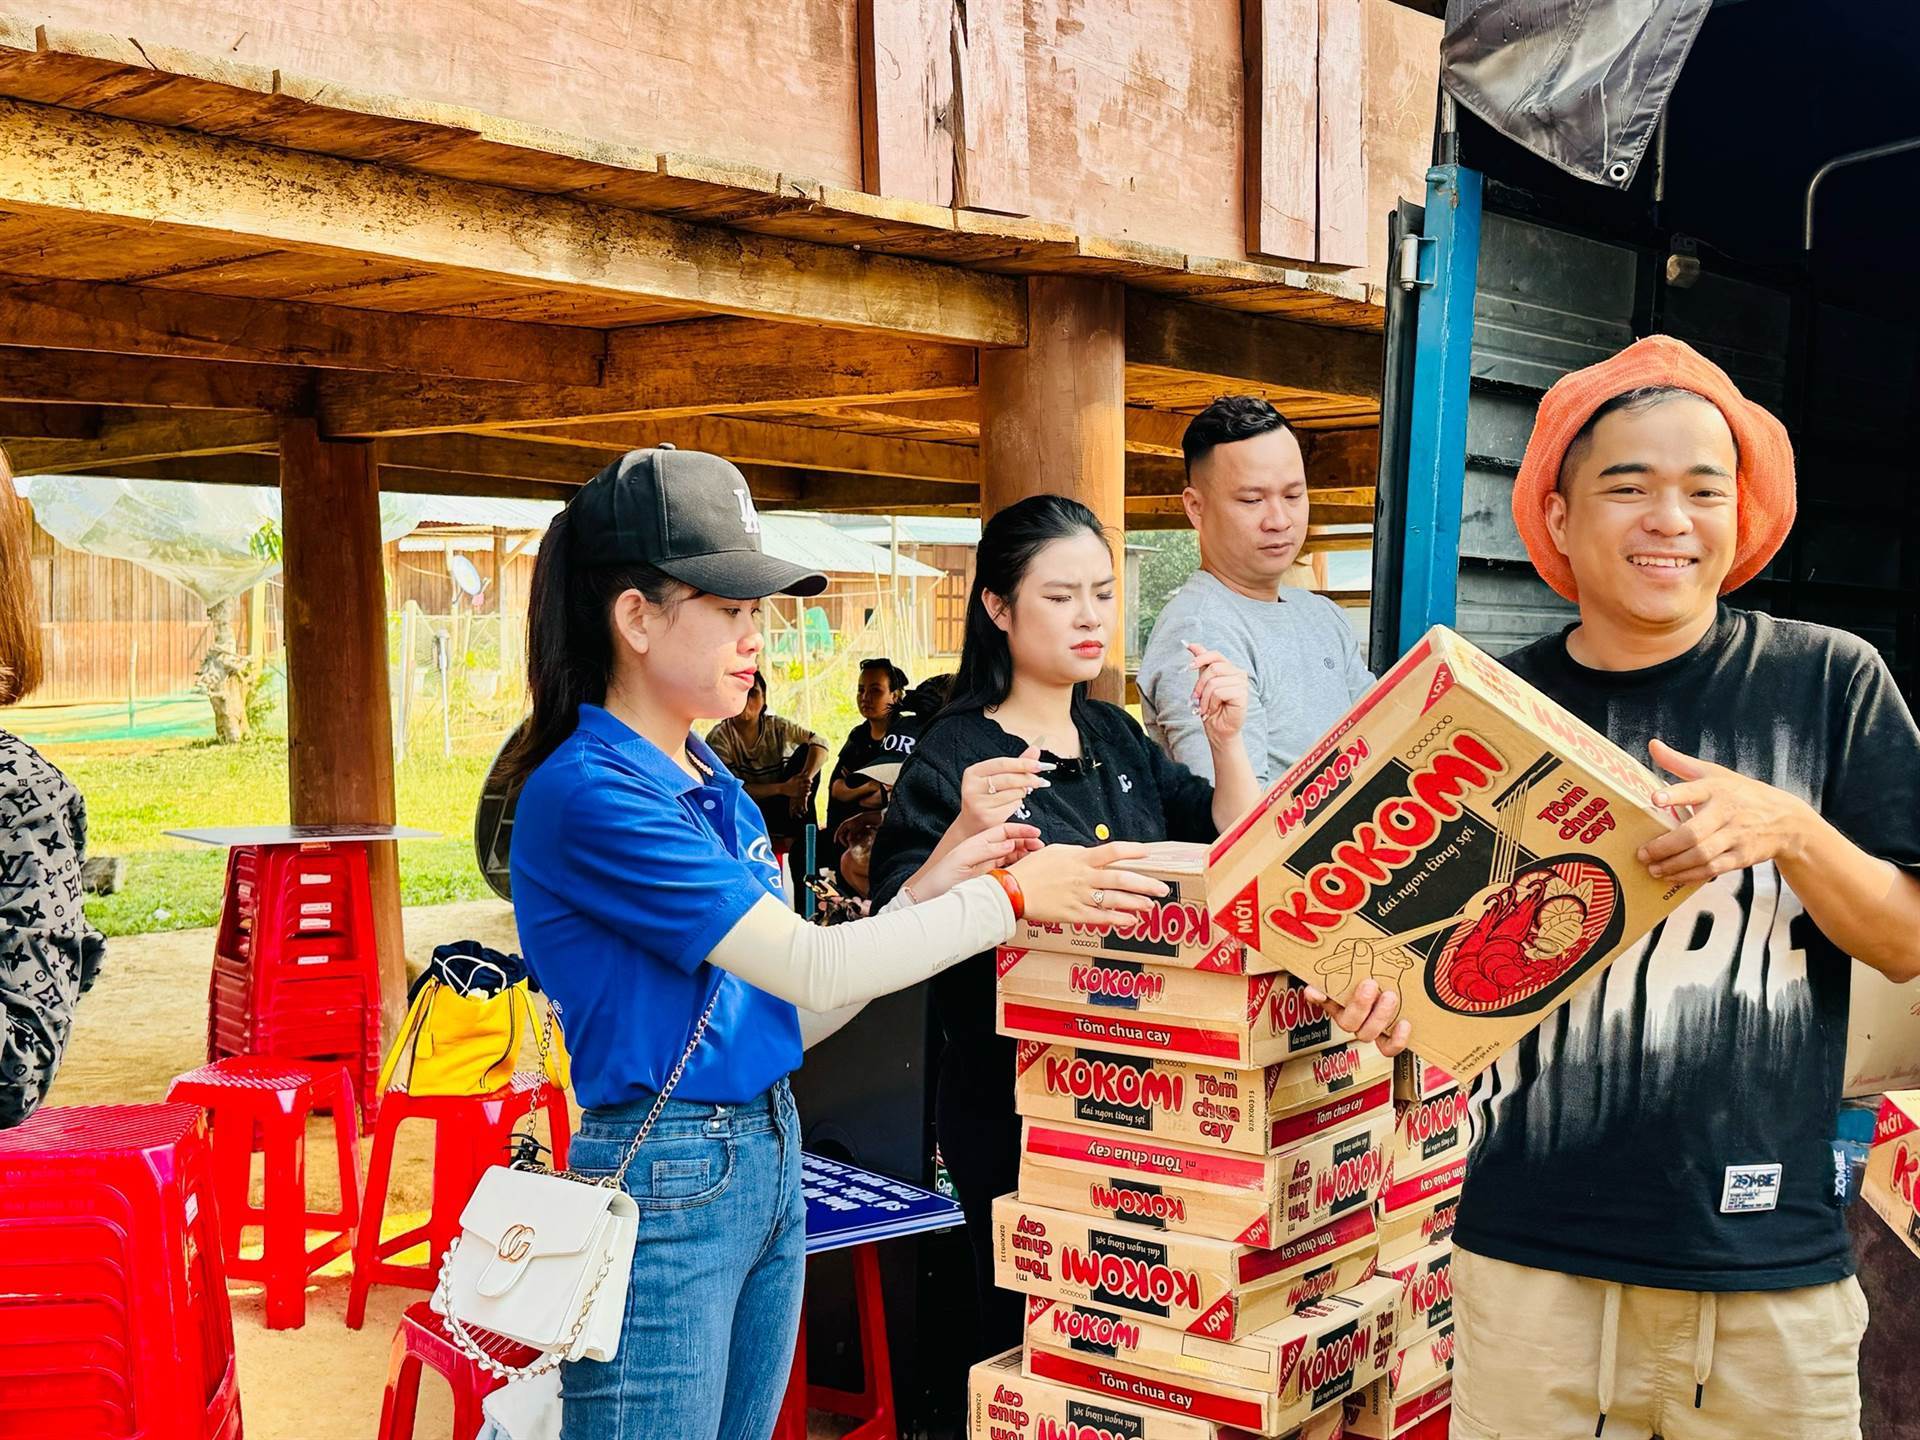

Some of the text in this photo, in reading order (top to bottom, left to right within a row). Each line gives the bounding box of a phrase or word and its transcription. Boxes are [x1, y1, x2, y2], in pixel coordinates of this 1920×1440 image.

[882, 734, 915, 754] OR
[1276, 737, 1369, 837] KOKOMI
[1536, 785, 1589, 825] Tôm
[1558, 796, 1610, 841] chua
[1268, 732, 1506, 945] KOKOMI
[1579, 810, 1617, 844] cay
[1377, 895, 1399, 917] dai
[1397, 868, 1430, 901] ngon
[1233, 899, 1253, 934] MỚI
[1070, 965, 1165, 1000] KOKOMI
[1075, 1018, 1106, 1035] Tôm
[1109, 1024, 1143, 1040] chua
[1146, 1030, 1171, 1045] cay
[1312, 1049, 1361, 1084] KOKOMI
[1045, 1057, 1185, 1113] KOKOMI
[1195, 1074, 1238, 1099] Tôm
[1192, 1099, 1240, 1122] chua
[1333, 1104, 1350, 1120] chua
[1351, 1098, 1364, 1112] cay
[1406, 1090, 1469, 1147] KOKOM
[1200, 1120, 1234, 1144] cay
[1878, 1111, 1903, 1138] MỚI
[1088, 1141, 1112, 1158] cay
[1115, 1147, 1149, 1164] chua
[1151, 1156, 1184, 1173] Tôm
[1291, 1158, 1310, 1181] cay
[1315, 1147, 1384, 1211] KOKOMI
[1834, 1149, 1845, 1197] ZOMBIE
[1288, 1175, 1313, 1199] chua
[1091, 1184, 1187, 1221] KOKOMI
[1017, 1214, 1046, 1237] cay
[1247, 1223, 1266, 1242] MỚI
[1012, 1234, 1053, 1259] chua
[1280, 1231, 1337, 1260] Tôm chua cay
[1015, 1255, 1052, 1281] Tôm
[1061, 1247, 1200, 1310] KOKOMI
[1286, 1269, 1339, 1309] KOKOMI
[1053, 1309, 1141, 1351] KOKOMI
[1203, 1305, 1230, 1334] MỚI
[1299, 1325, 1371, 1396] KOKOMI
[993, 1385, 1024, 1407] cay
[1098, 1372, 1129, 1392] Tôm
[1132, 1380, 1166, 1401] chua
[1168, 1391, 1193, 1410] cay
[988, 1403, 1030, 1429] chua
